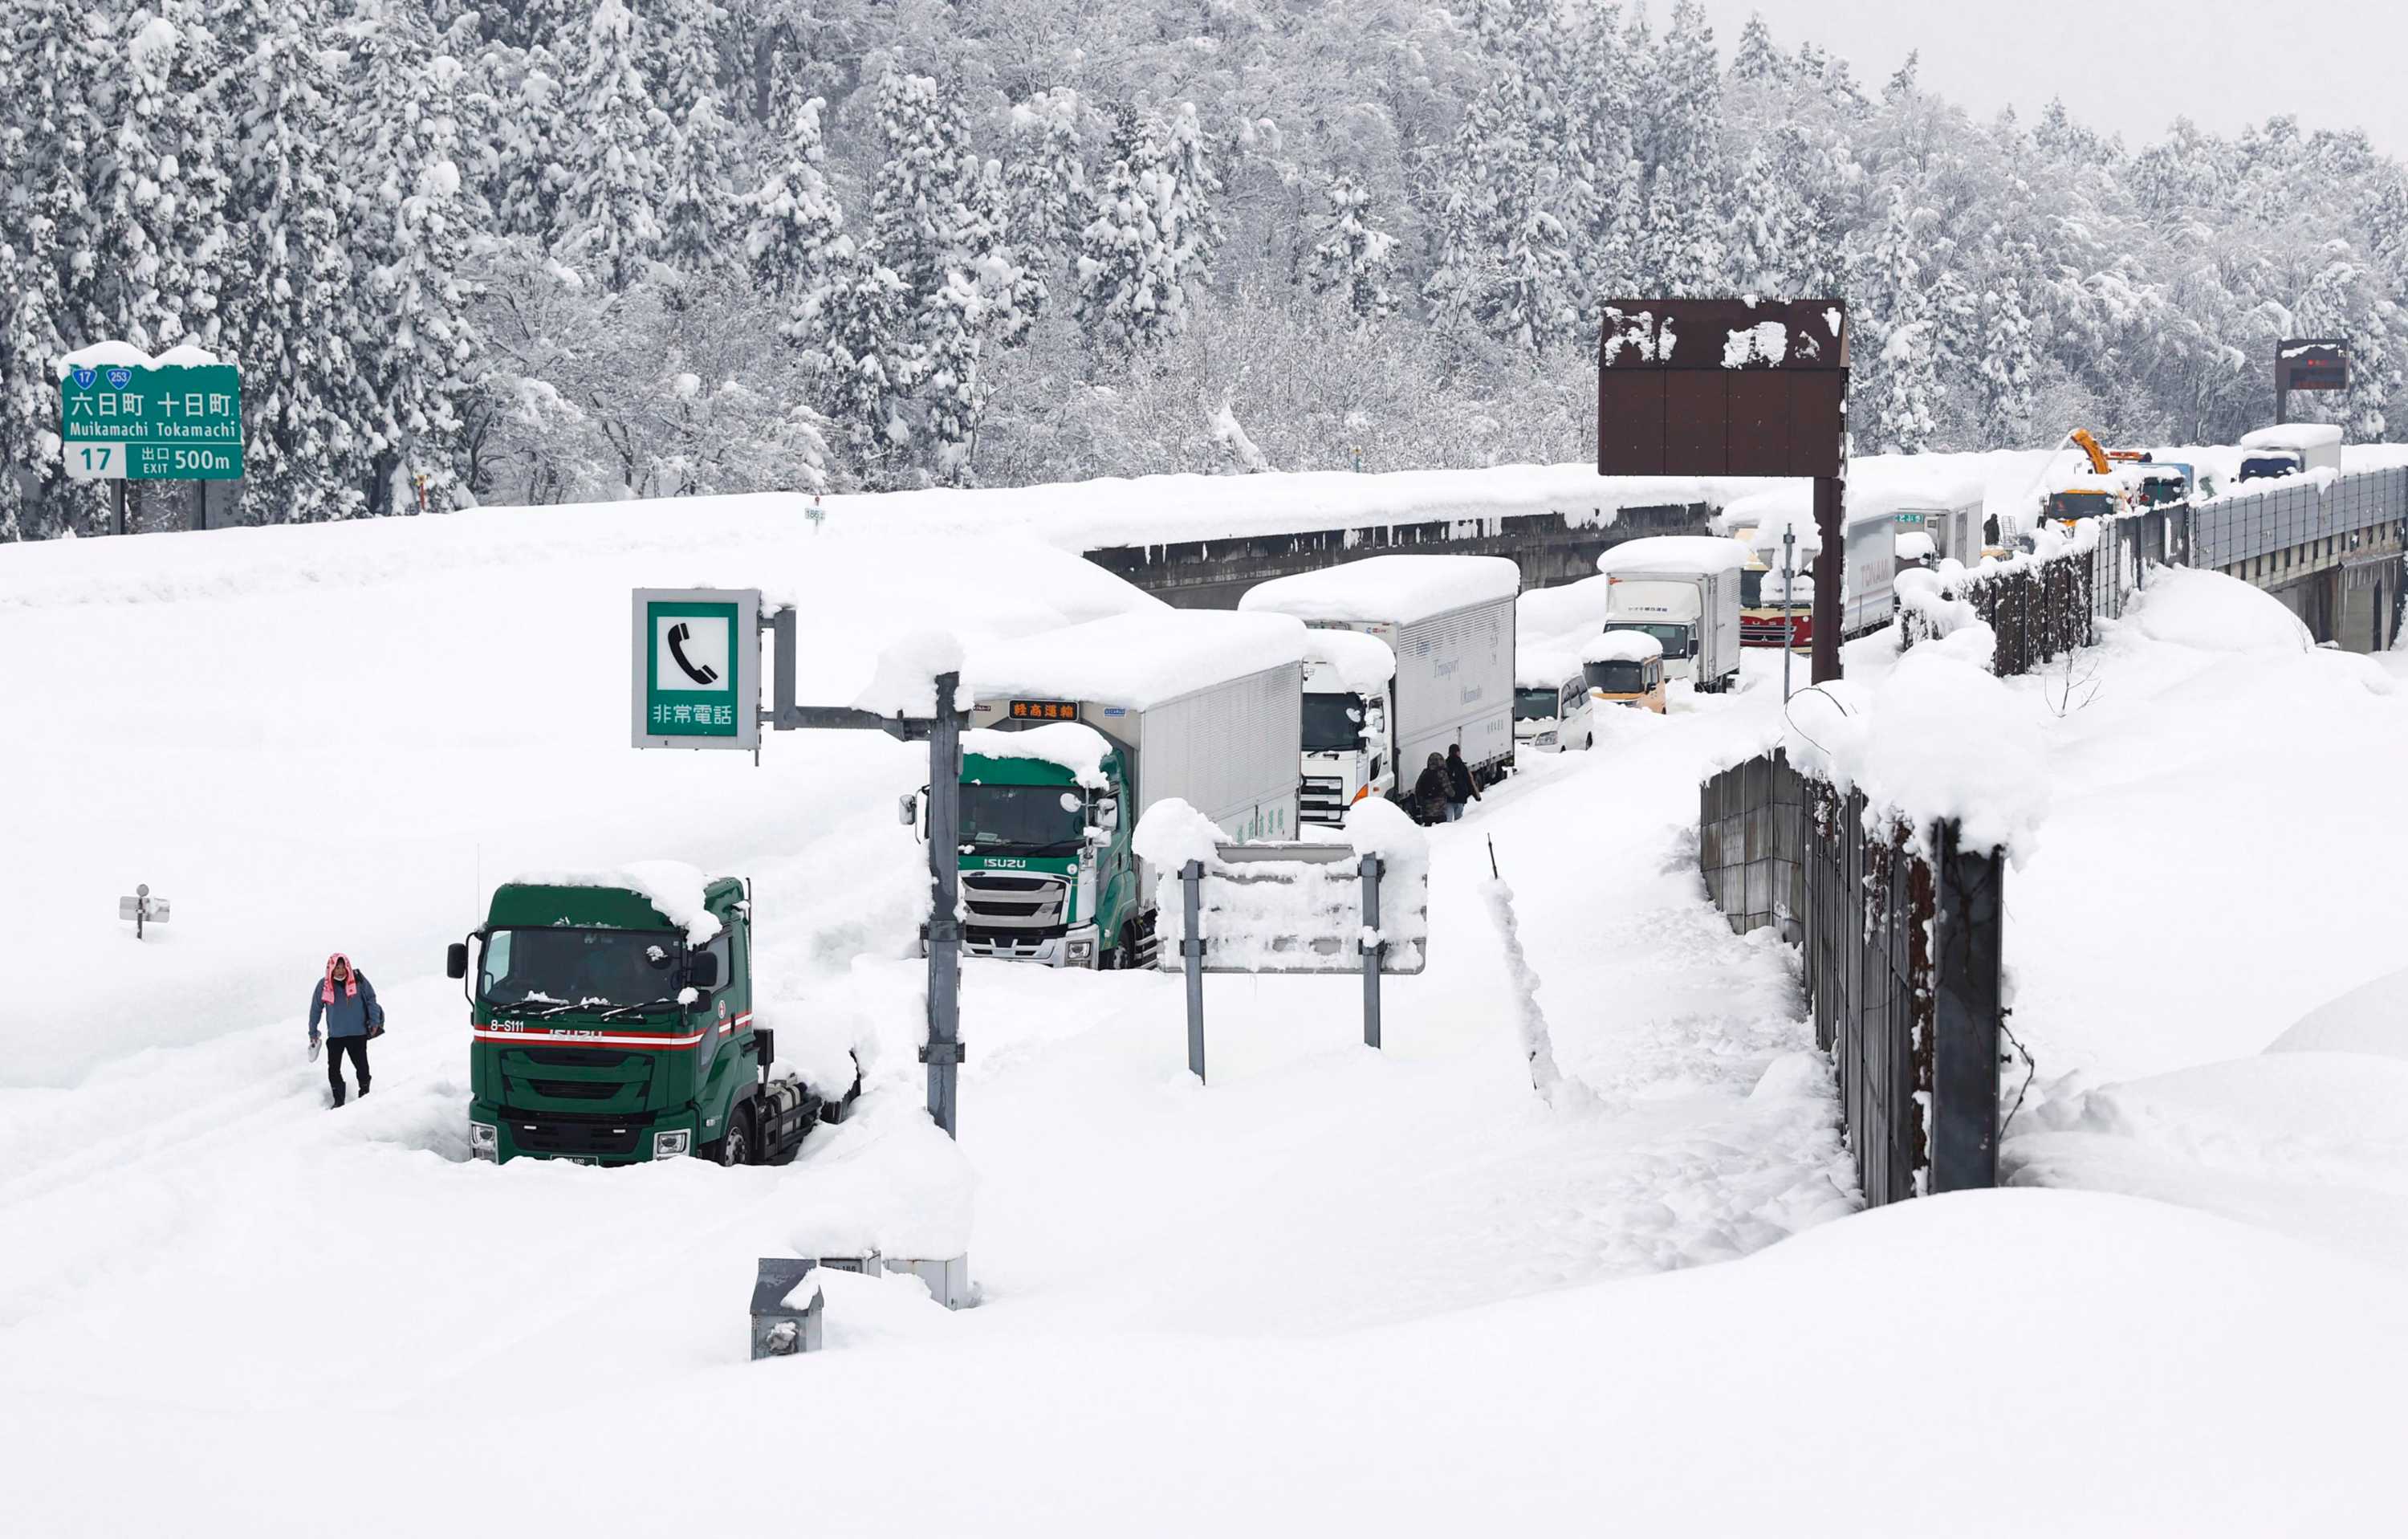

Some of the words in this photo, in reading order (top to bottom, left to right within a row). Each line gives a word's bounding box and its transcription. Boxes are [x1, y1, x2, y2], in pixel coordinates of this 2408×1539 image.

[79, 372, 91, 383] 17
[111, 372, 128, 383] 253
[71, 392, 144, 417] 六日町
[157, 392, 231, 417] 十日町
[70, 421, 148, 437] Muikamachi
[157, 421, 235, 438] Tokamachi
[80, 448, 112, 470] 17
[141, 447, 169, 461] 出口
[175, 450, 230, 470] 500m
[143, 463, 168, 474] EXIT
[653, 704, 732, 725] 非常電話
[984, 857, 1026, 868] ISUZU
[490, 1019, 524, 1032] 8-S111
[549, 1028, 602, 1040] ISUZU
